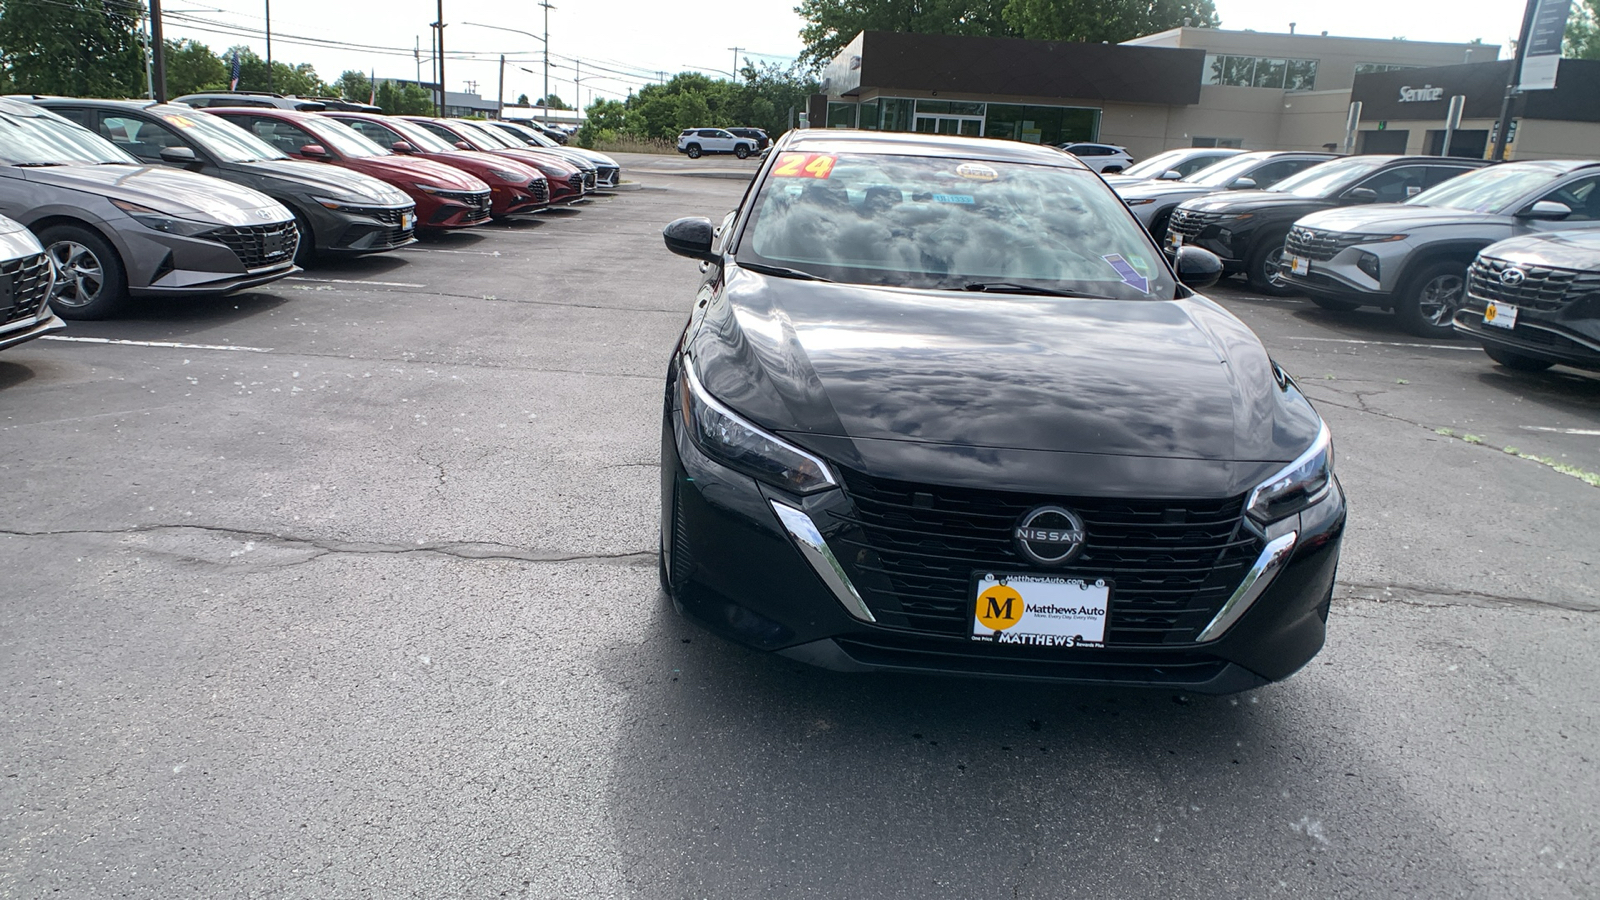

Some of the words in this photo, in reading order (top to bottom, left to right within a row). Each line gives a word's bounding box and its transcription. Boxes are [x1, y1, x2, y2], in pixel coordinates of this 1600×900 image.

[1398, 84, 1443, 102] Service
[774, 154, 833, 178] 24
[1017, 528, 1083, 542] NISSAN
[1005, 575, 1085, 585] MatthewsAuto.com
[983, 597, 1016, 620] M
[1025, 603, 1077, 615] Matthews
[1078, 605, 1105, 616] Auto
[998, 633, 1075, 648] MATTHEWS
